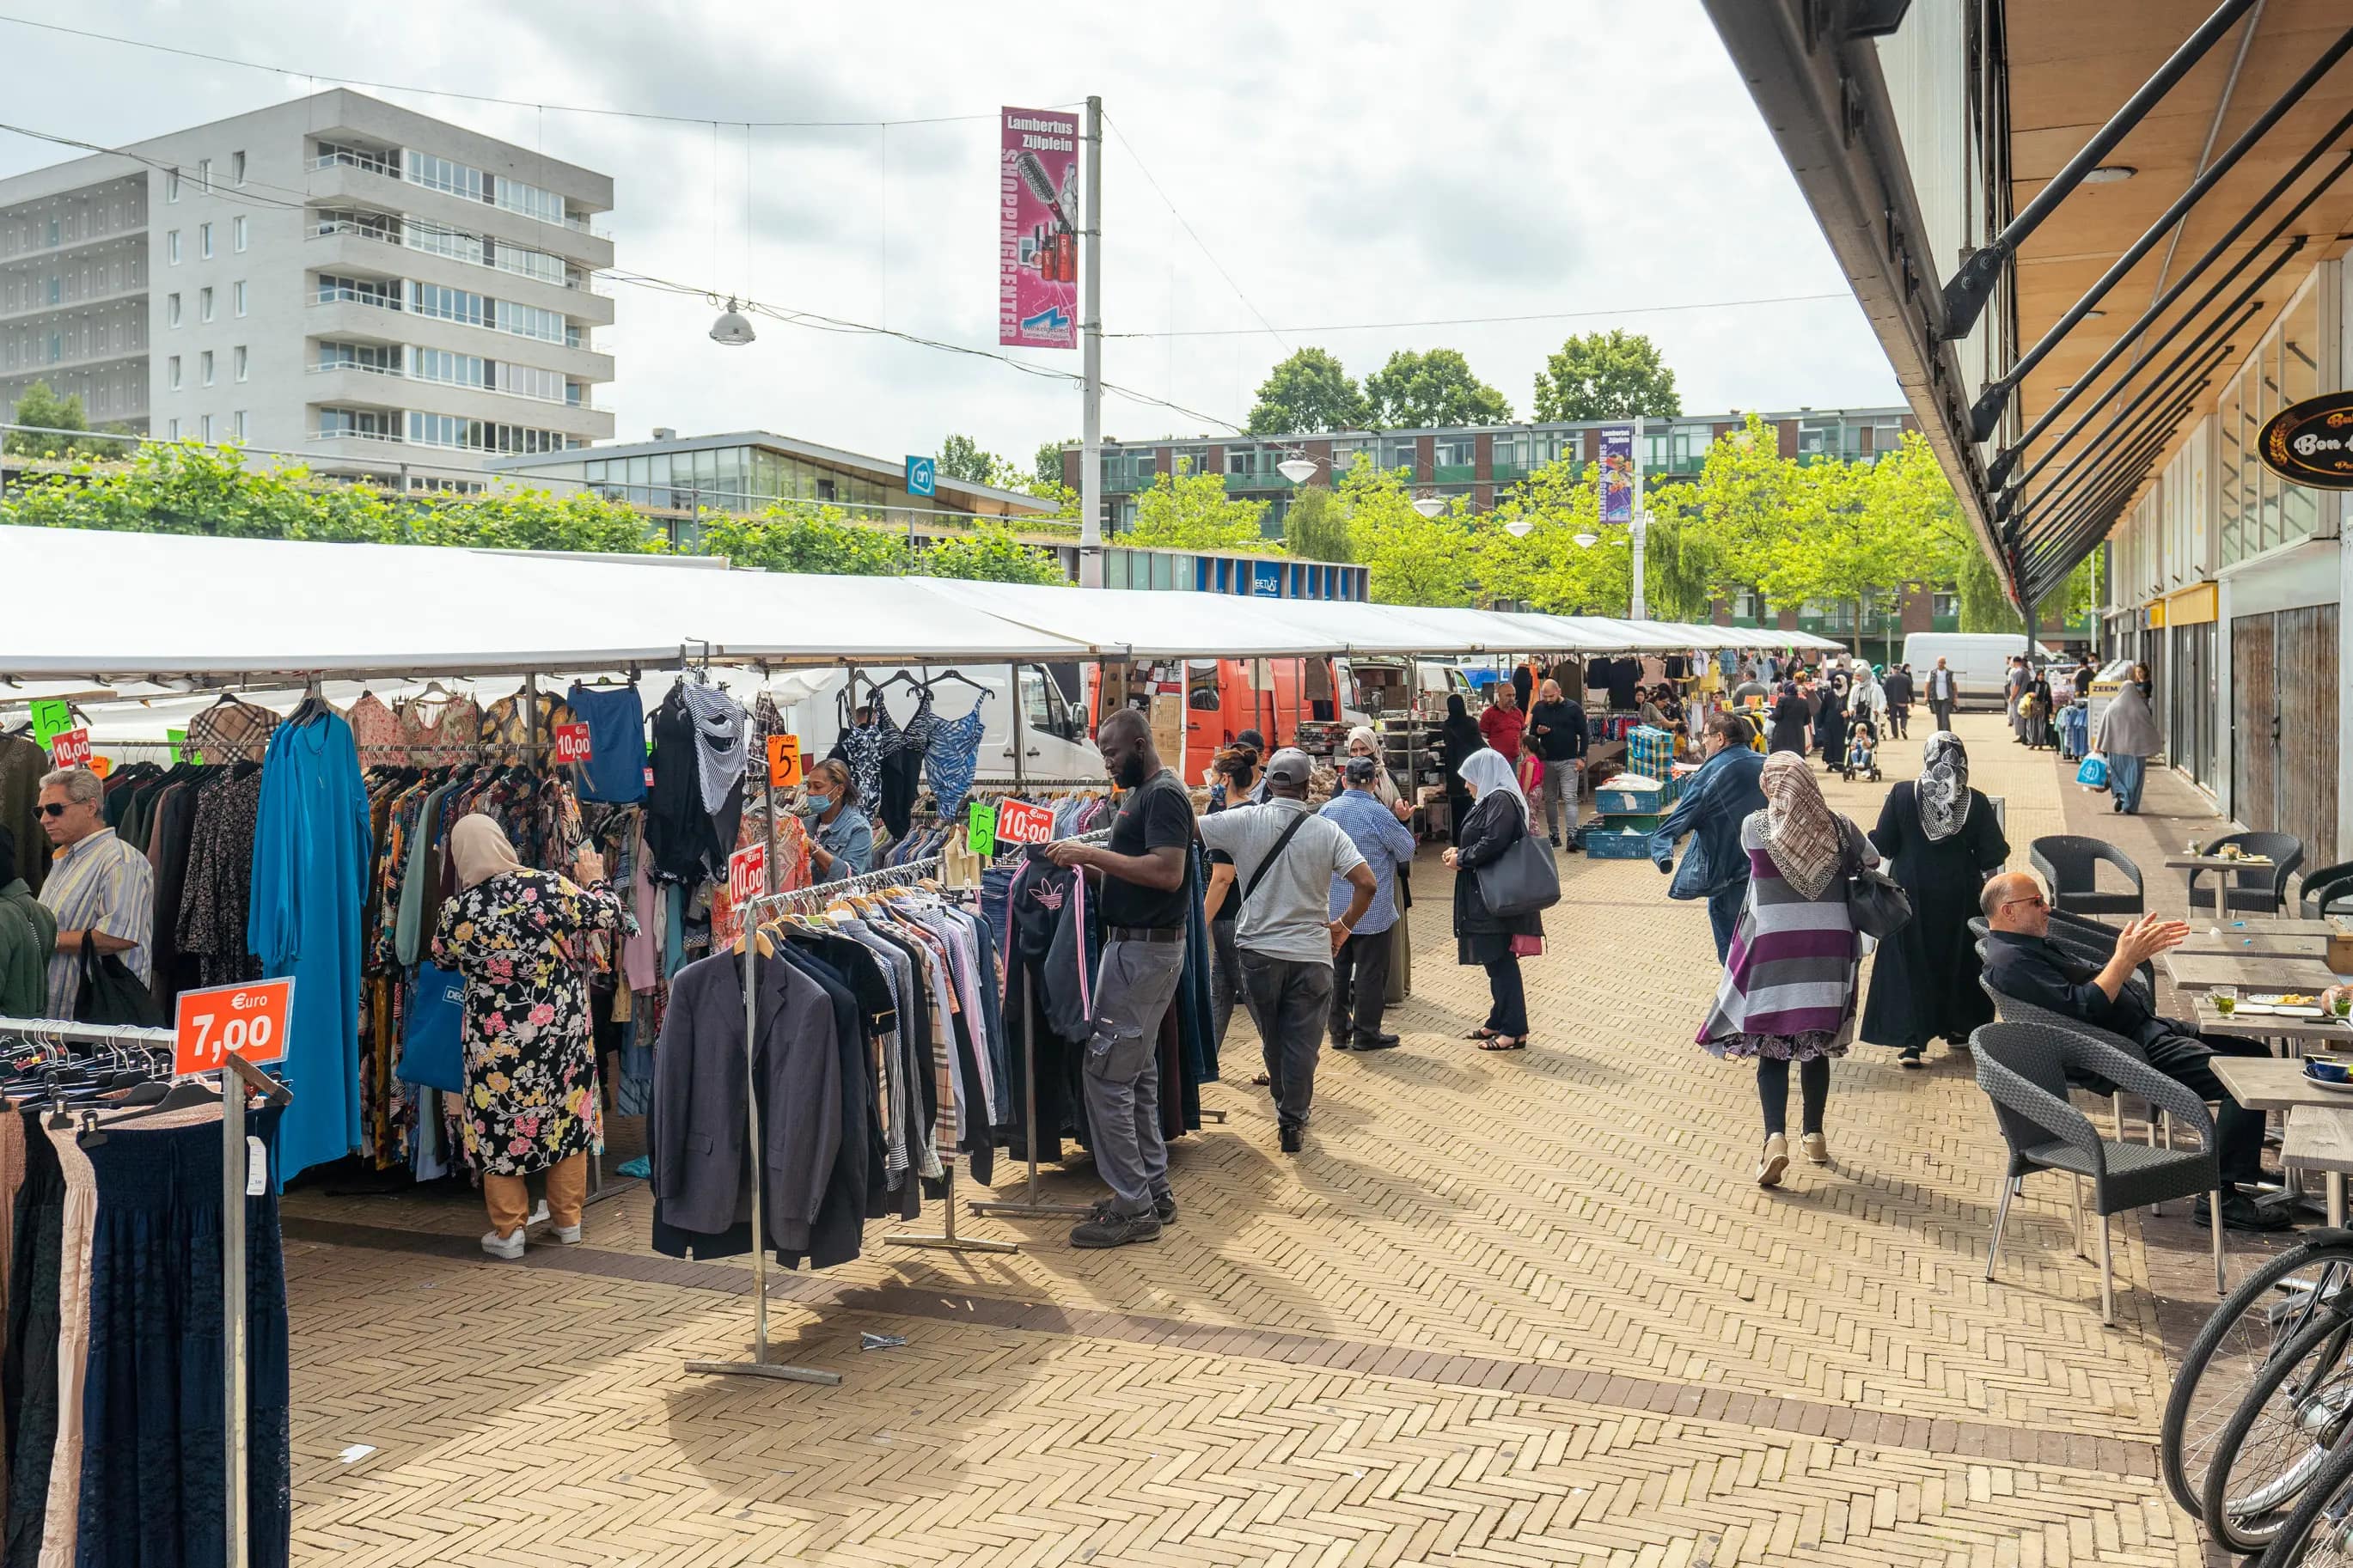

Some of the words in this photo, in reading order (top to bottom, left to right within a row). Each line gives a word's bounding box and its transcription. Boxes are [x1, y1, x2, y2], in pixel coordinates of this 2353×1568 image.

[1007, 115, 1073, 135] Lambertus
[1022, 134, 1073, 152] Zijlplein
[1000, 148, 1018, 338] SHOPPINGCENTER
[56, 741, 89, 763] 10,00
[558, 734, 590, 759] 10,00
[1004, 808, 1049, 843] 10,00
[192, 1013, 272, 1065] 7,00
